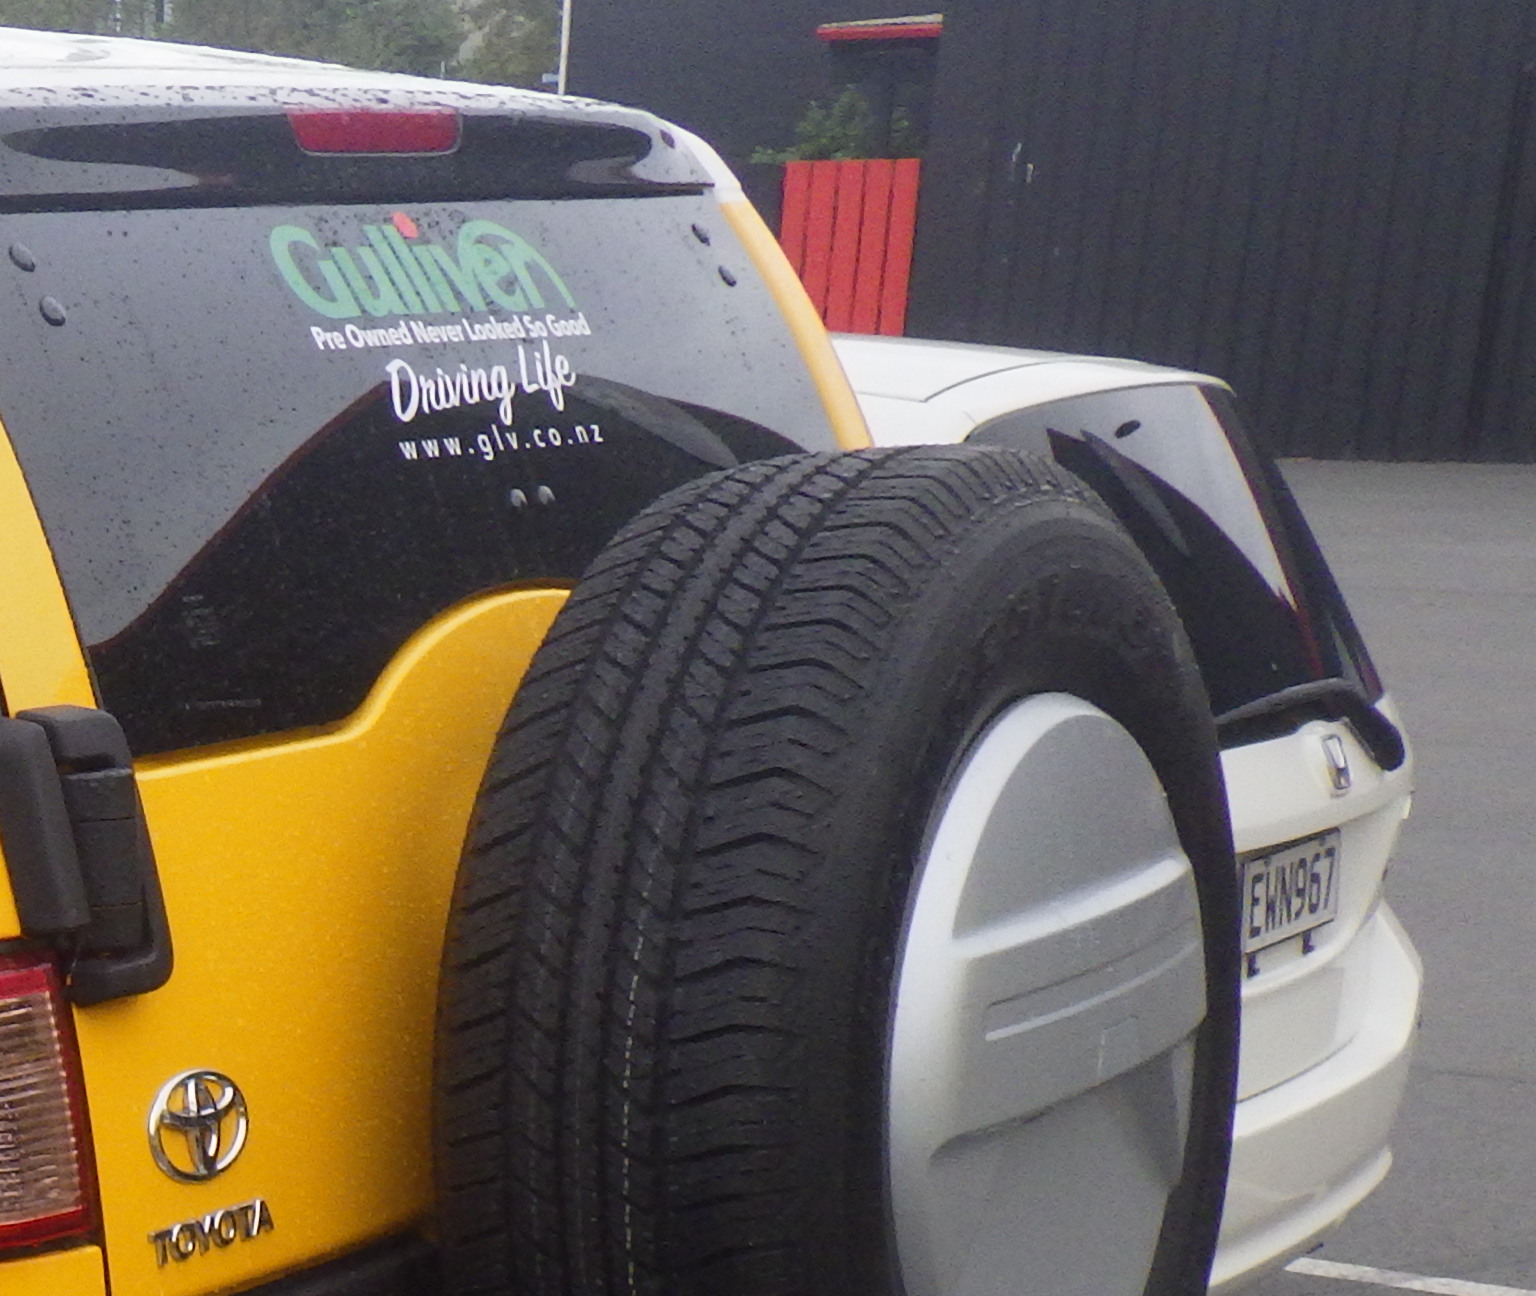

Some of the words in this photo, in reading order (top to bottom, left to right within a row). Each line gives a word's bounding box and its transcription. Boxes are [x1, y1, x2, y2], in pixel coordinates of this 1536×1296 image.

[269, 212, 576, 318] Gulliver
[311, 326, 346, 350] Pre
[345, 320, 413, 348] Owned
[410, 320, 464, 343] Never
[462, 315, 525, 341] Looked
[523, 315, 548, 338] So
[546, 312, 591, 336] Good
[385, 358, 516, 426] Driving
[518, 340, 576, 411] Life
[399, 424, 604, 461] www.glv.co.nz
[1248, 846, 1336, 939] EWN967
[148, 1199, 274, 1269] TOYOTA
